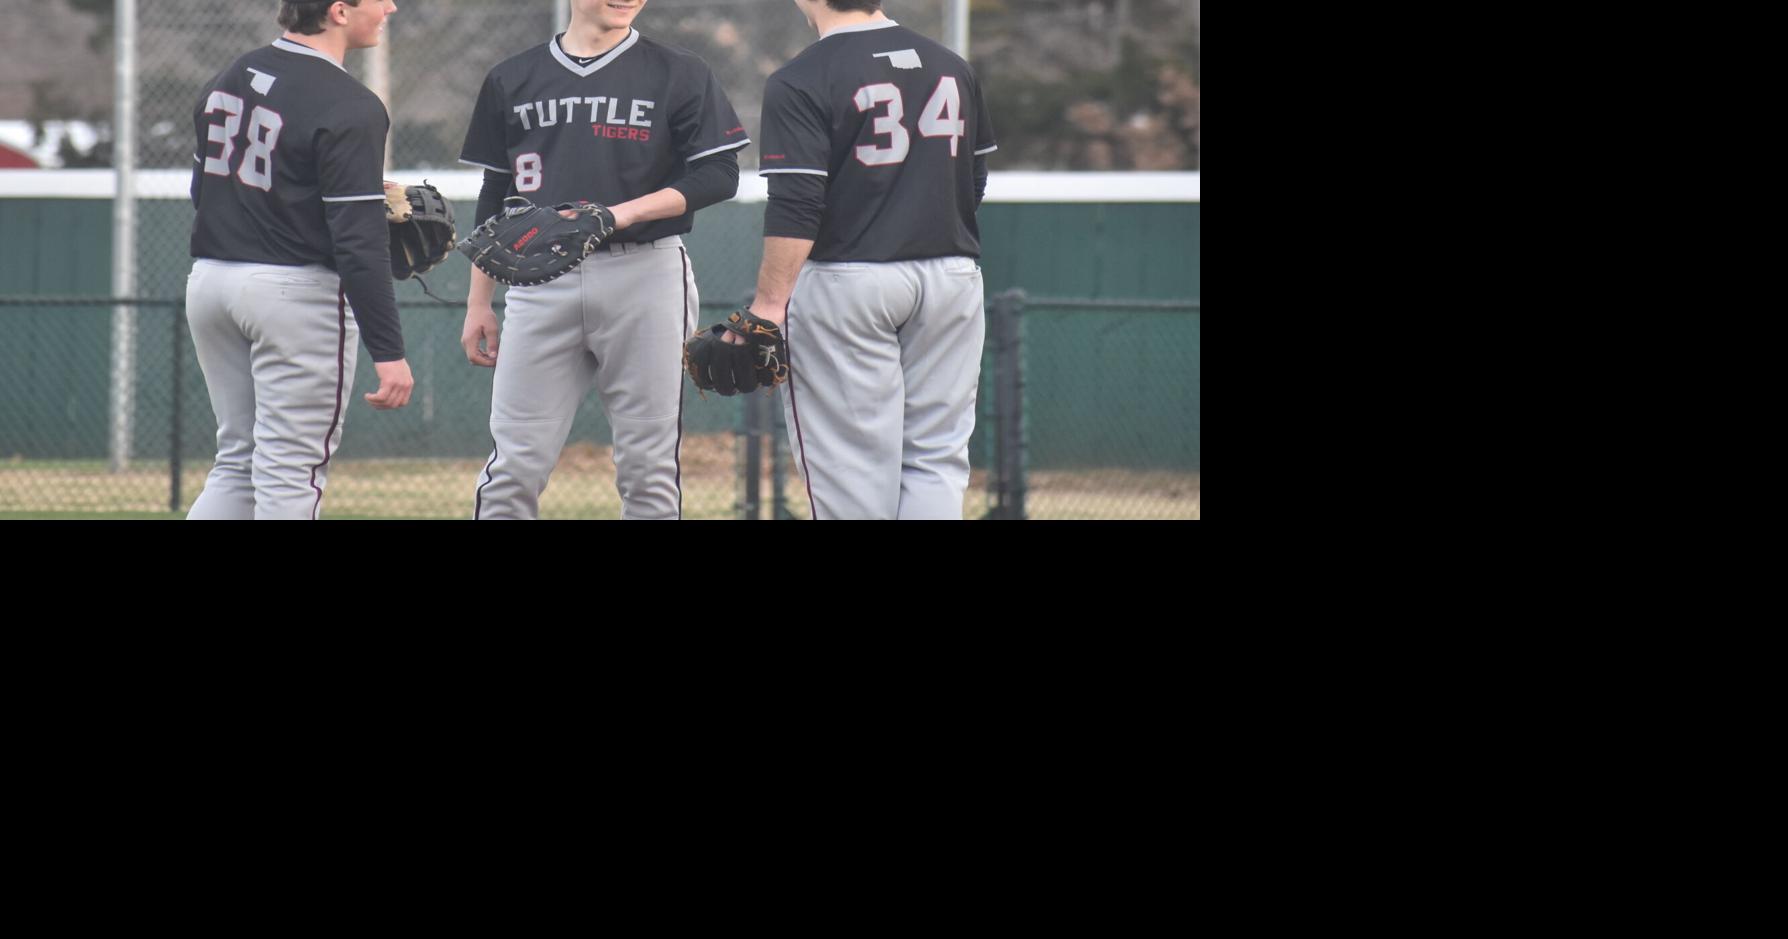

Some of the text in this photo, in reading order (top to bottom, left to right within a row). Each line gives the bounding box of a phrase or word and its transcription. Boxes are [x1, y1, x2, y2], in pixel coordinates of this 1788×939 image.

[513, 96, 655, 130] TUTTLE
[592, 124, 650, 142] TIGERS
[853, 75, 965, 166] 34
[203, 90, 284, 192] 38
[514, 152, 543, 192] 8
